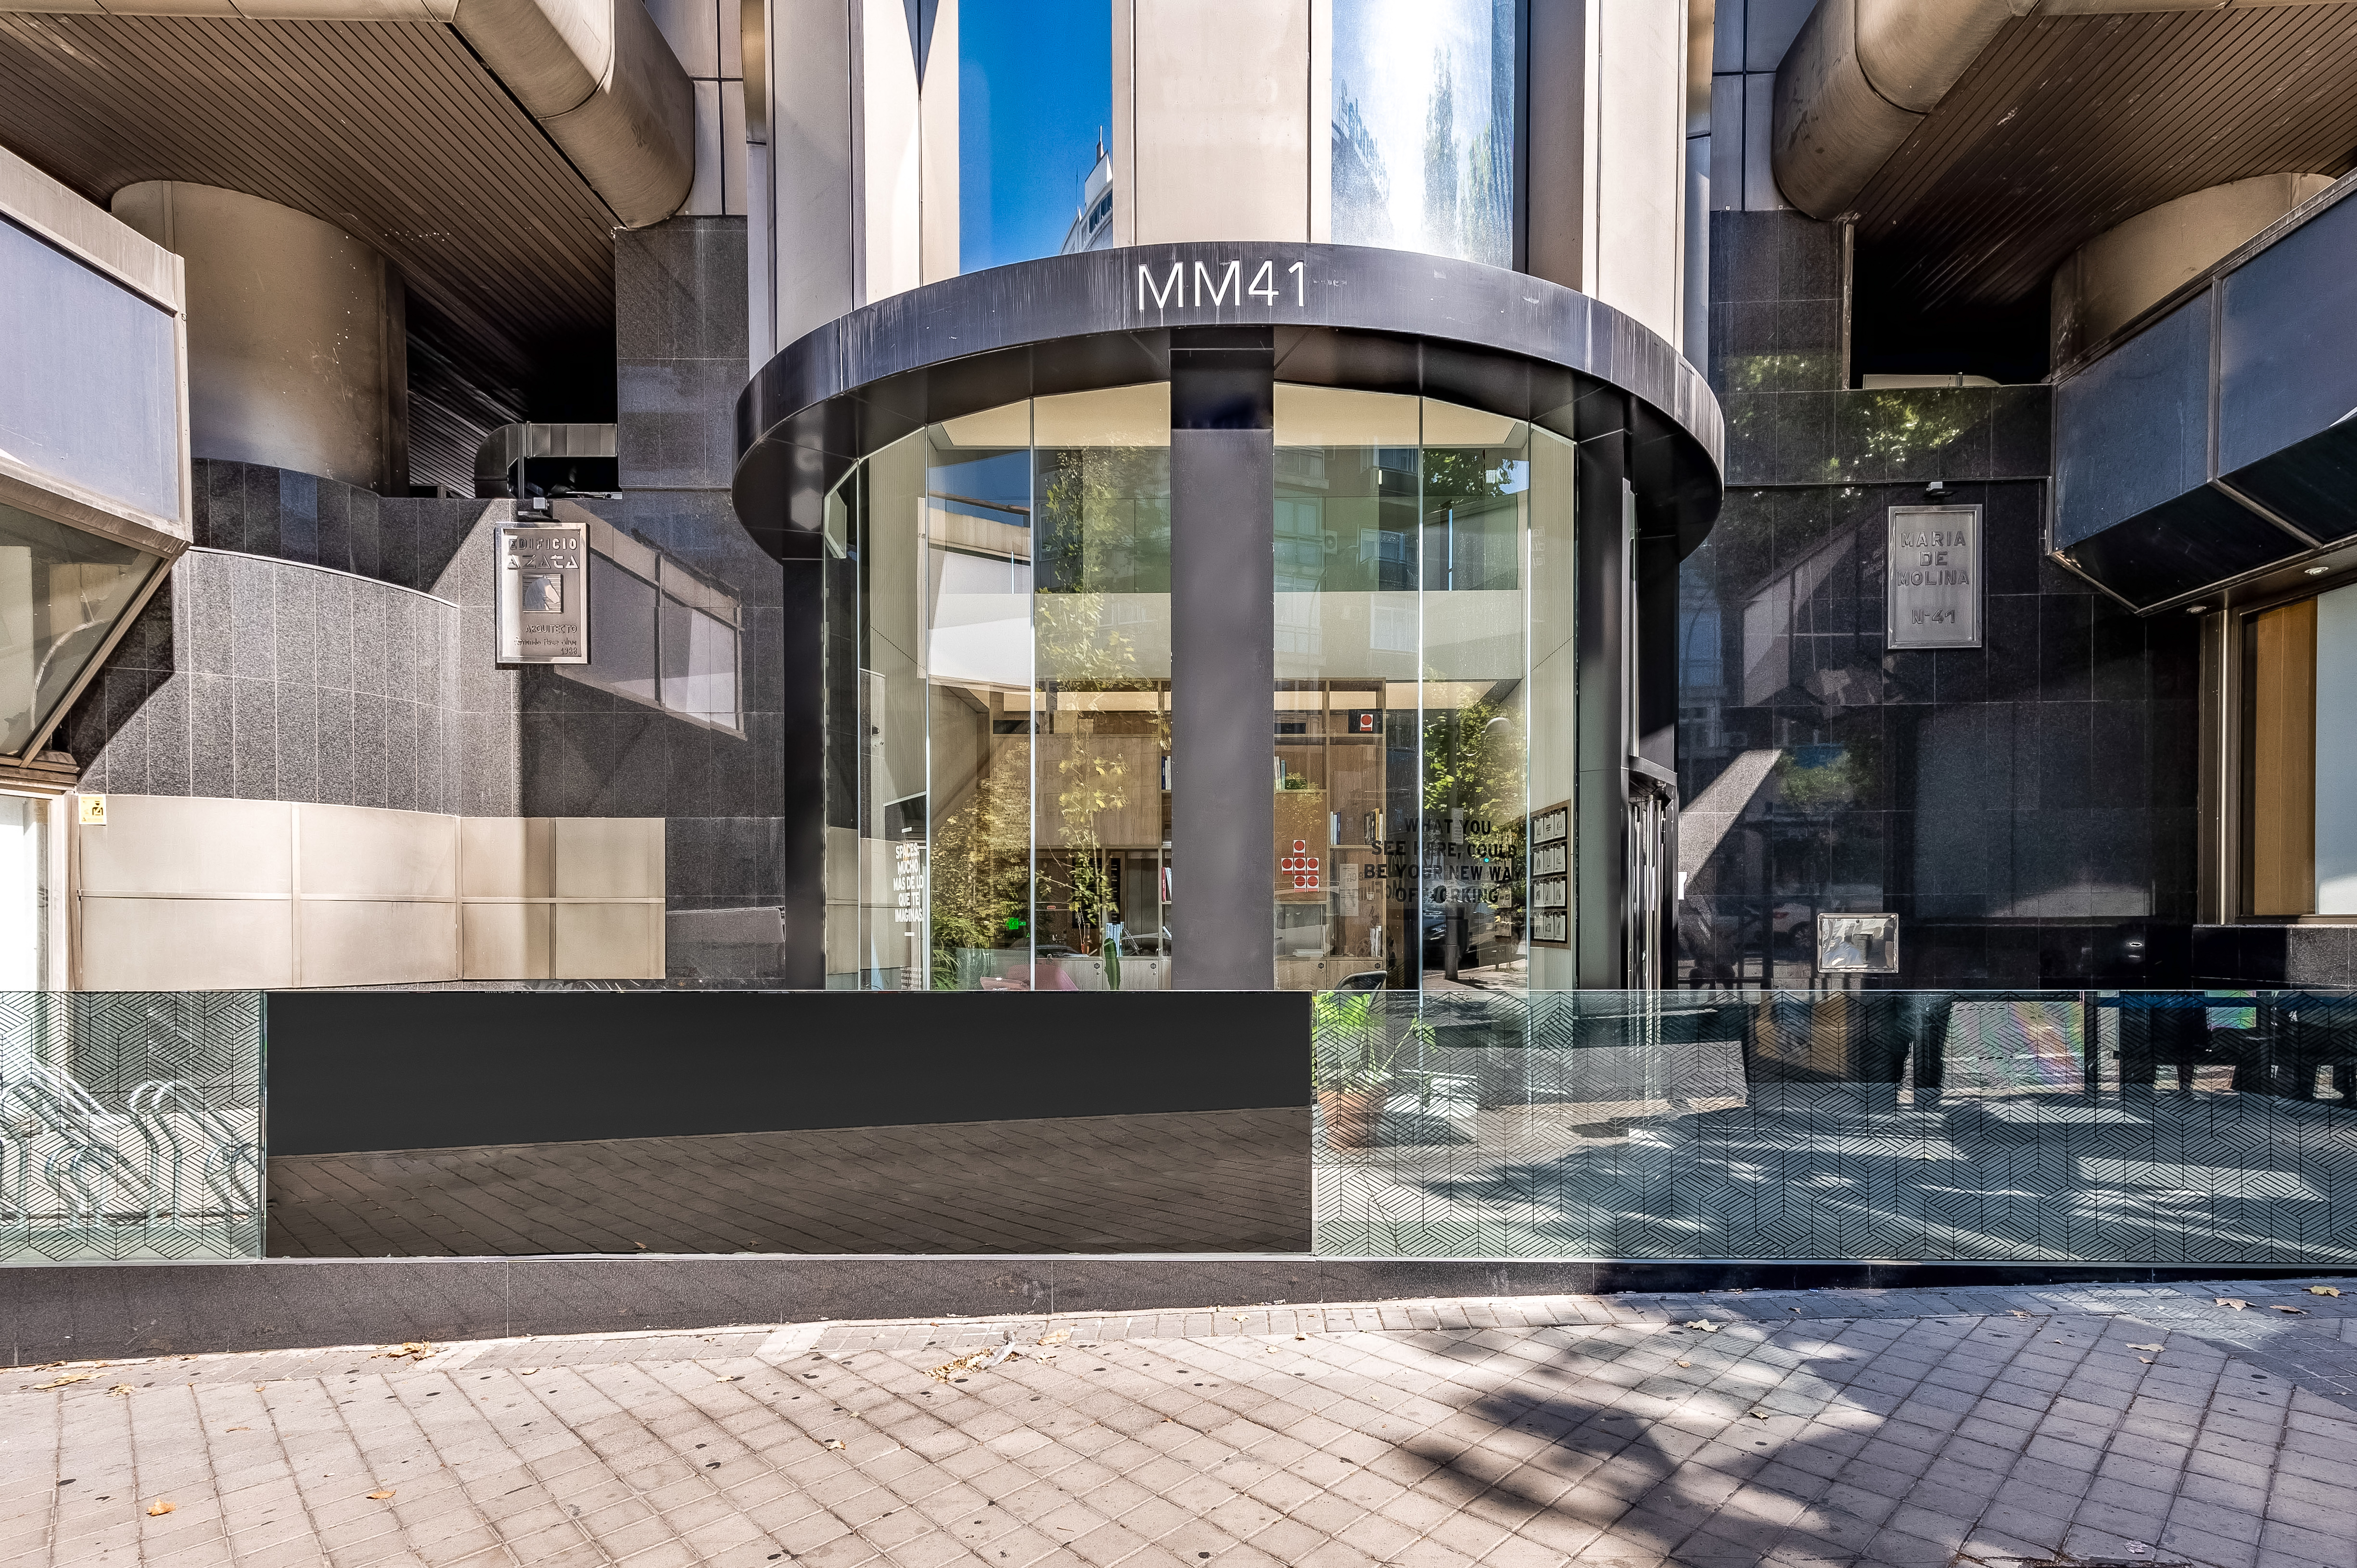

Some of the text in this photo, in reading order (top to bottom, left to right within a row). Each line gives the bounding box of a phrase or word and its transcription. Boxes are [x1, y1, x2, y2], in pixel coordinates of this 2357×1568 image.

[1138, 259, 1305, 311] MM41
[509, 537, 577, 550] EDIFICIO
[1901, 530, 1966, 547] MARIA
[1919, 550, 1948, 567] DE
[1896, 569, 1970, 587] MOLINA
[525, 624, 577, 633] ARQUITECTO
[1404, 818, 1453, 834] WHAT
[1459, 819, 1491, 835] YOU
[1371, 840, 1406, 856] SEE
[1467, 843, 1517, 858] COULD
[897, 859, 919, 875] MUCHO
[1364, 863, 1522, 881] BE YOUR NEW WAY
[893, 874, 924, 891] MÁS DE LO
[898, 891, 920, 907] QUE TE
[1395, 887, 1418, 903] OF
